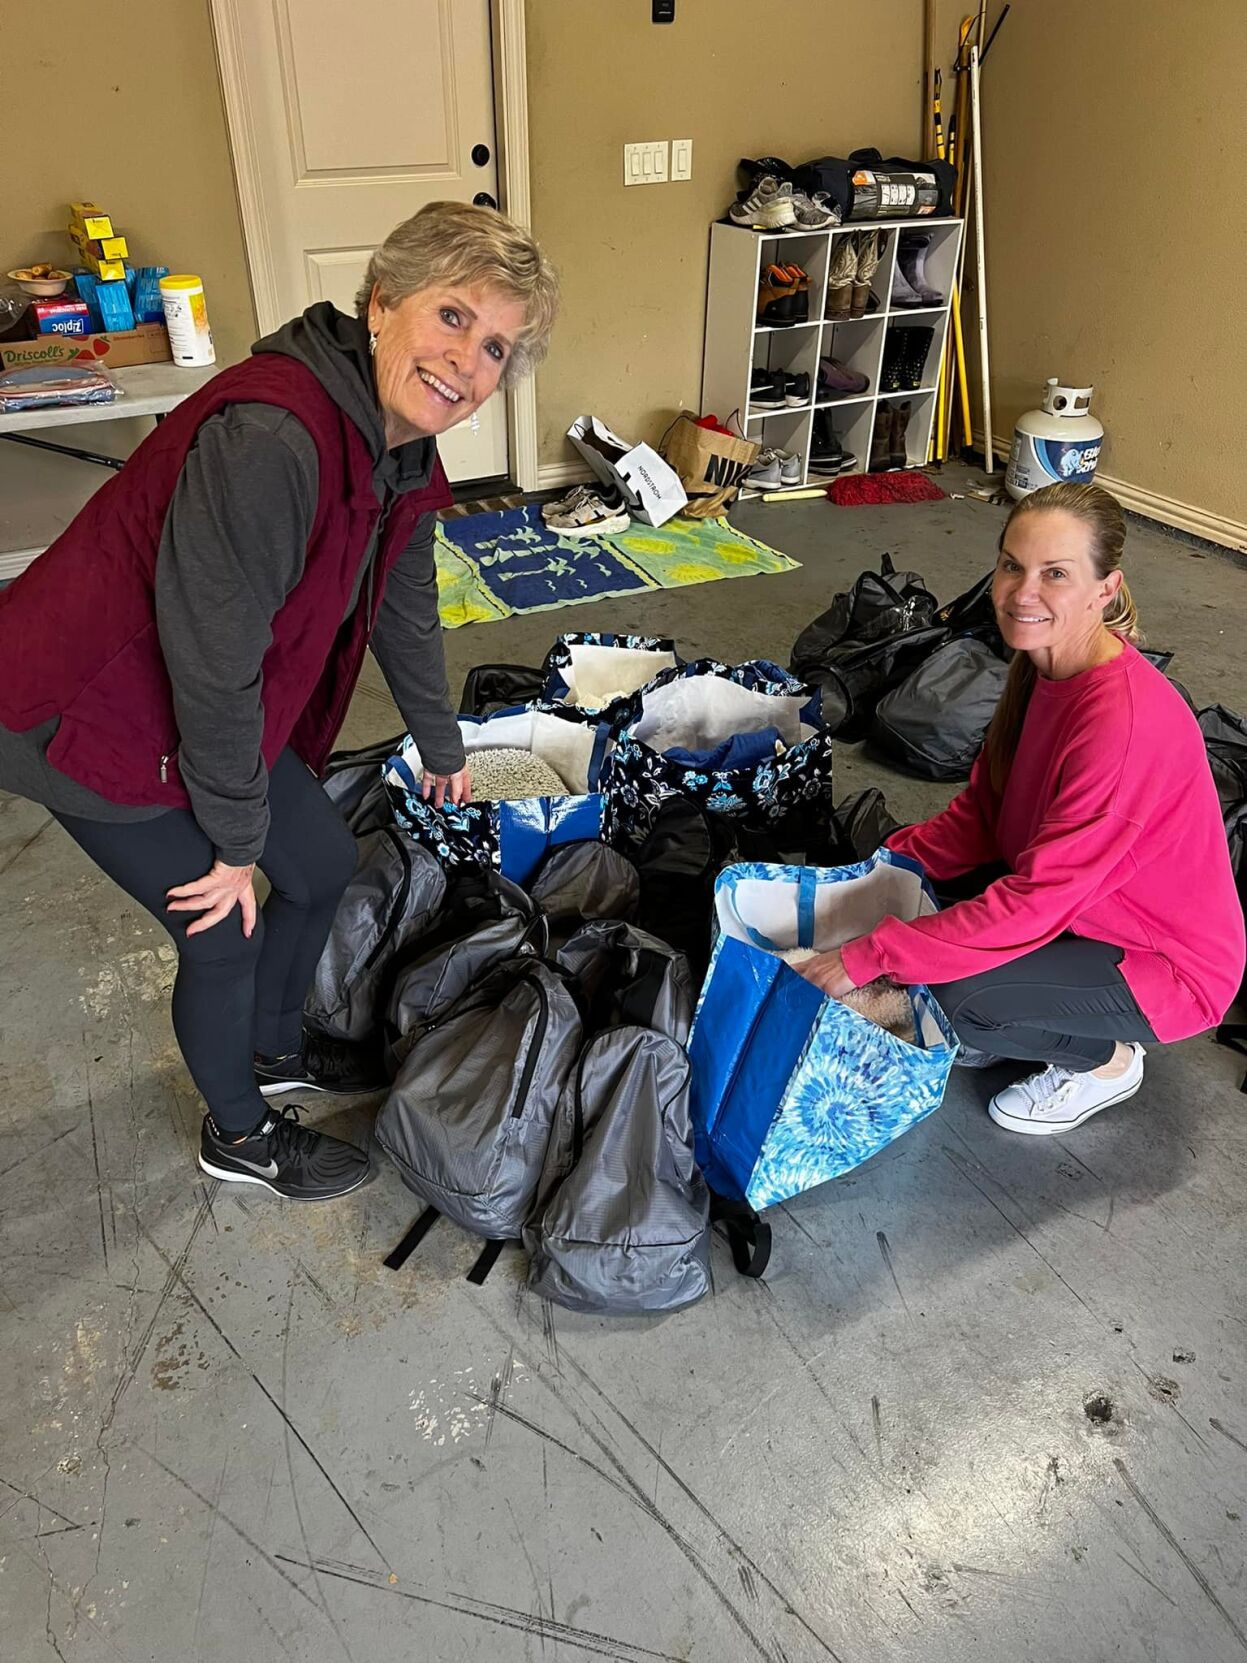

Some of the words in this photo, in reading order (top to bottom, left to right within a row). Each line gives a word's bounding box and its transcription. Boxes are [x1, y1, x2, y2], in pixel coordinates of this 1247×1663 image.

[52, 319, 82, 333] Ziploc
[4, 345, 64, 362] Driscoll's
[638, 465, 661, 499] NORDSTROM
[703, 453, 753, 488] NIK
